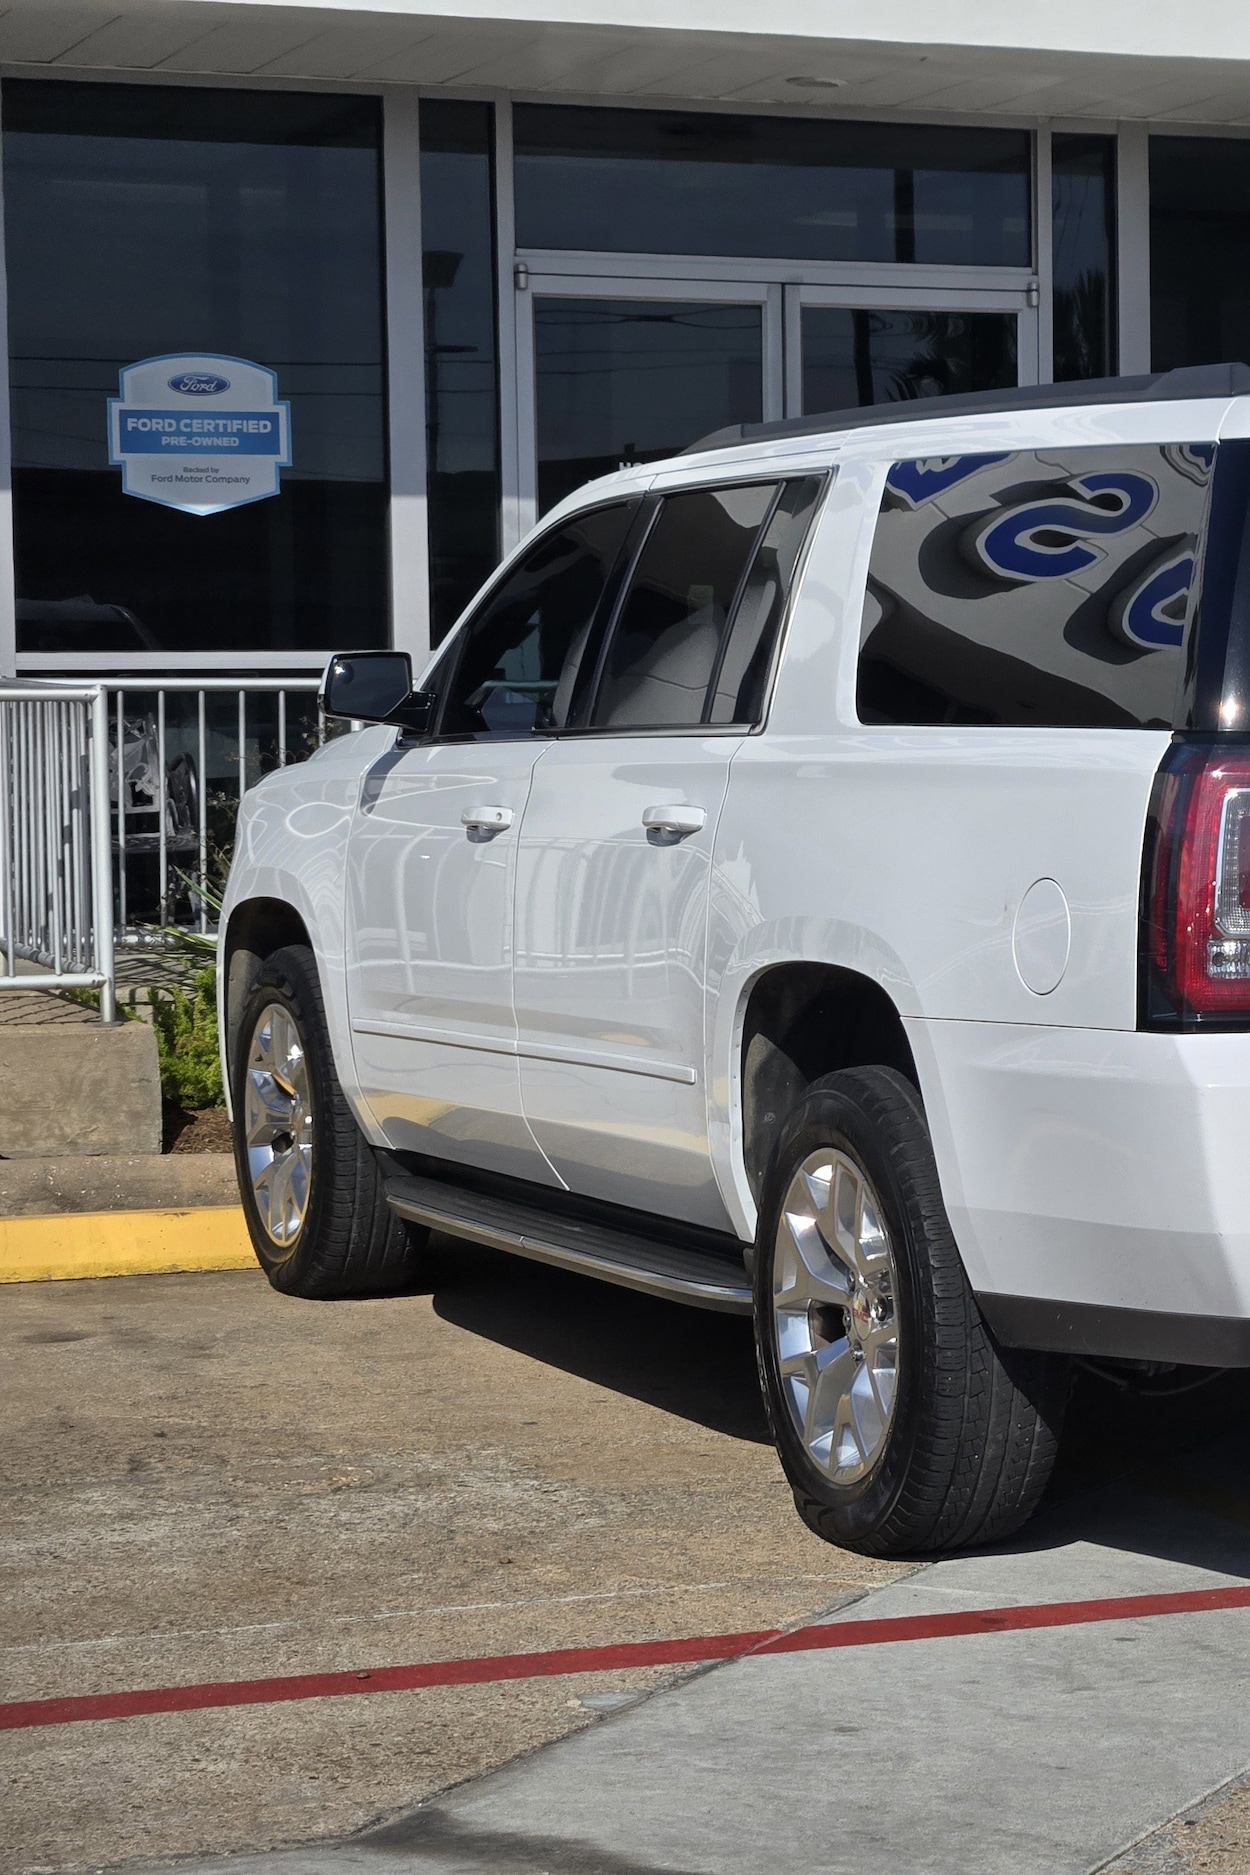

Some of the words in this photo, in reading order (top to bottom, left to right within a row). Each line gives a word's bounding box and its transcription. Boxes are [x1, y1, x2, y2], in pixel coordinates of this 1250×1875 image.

[180, 376, 217, 392] Ford
[127, 418, 177, 432] FORD
[180, 420, 272, 433] CERTIFIED
[161, 436, 239, 447] PRE-OWNED
[151, 475, 173, 483] Ford
[175, 475, 203, 483] Motor
[205, 475, 250, 485] Company
